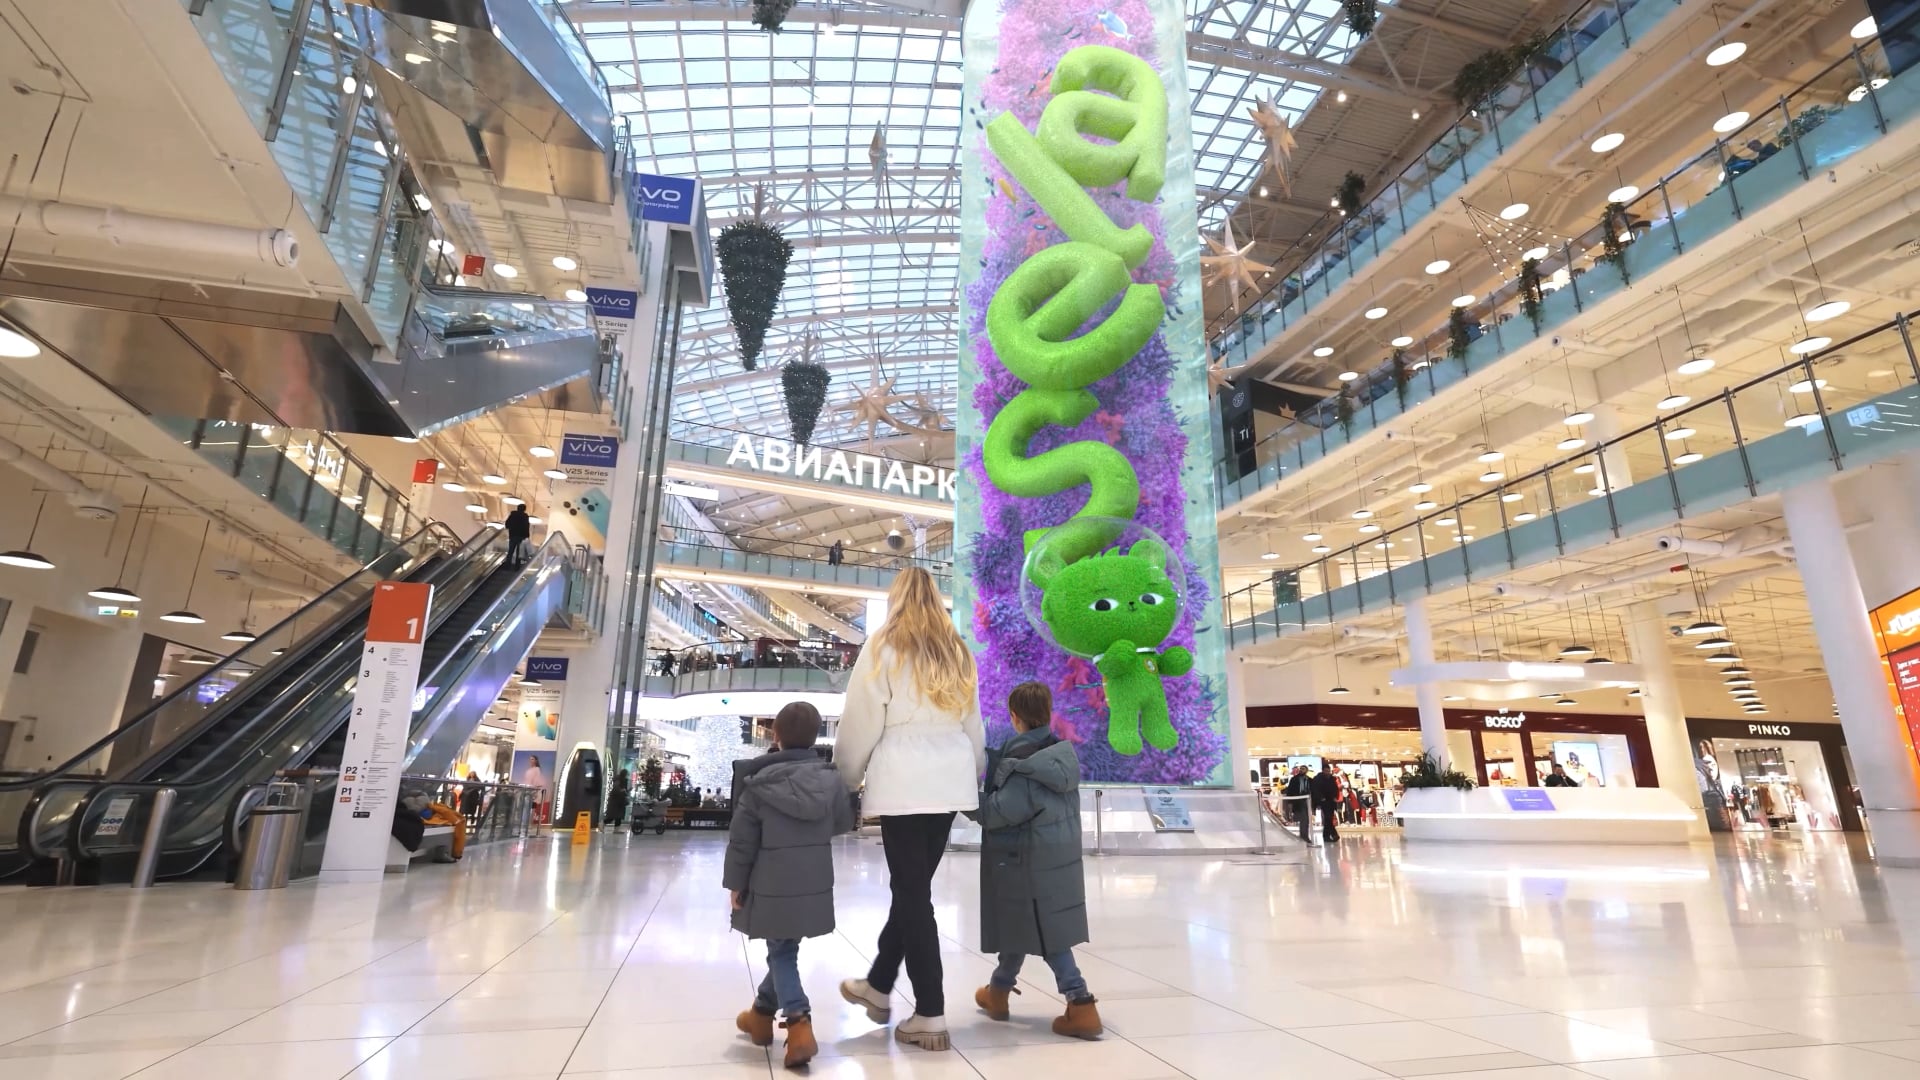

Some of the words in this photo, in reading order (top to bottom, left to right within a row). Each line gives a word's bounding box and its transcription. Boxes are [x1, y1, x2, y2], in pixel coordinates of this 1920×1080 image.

[474, 267, 482, 275] 3
[590, 294, 631, 307] vivo
[569, 441, 612, 454] vivo
[565, 467, 583, 475] V25
[584, 469, 609, 477] Series
[726, 435, 957, 501] АВИАПАРК
[426, 474, 435, 482] 2
[406, 617, 419, 640] 1
[367, 646, 375, 654] 4
[532, 661, 562, 671] vivo
[363, 670, 371, 678] 3
[356, 707, 363, 716] 2
[1484, 715, 1522, 729] BOSCO
[1748, 724, 1791, 736] PINKO
[351, 732, 357, 741] 1
[345, 766, 358, 775] P2
[341, 787, 353, 796] P1
